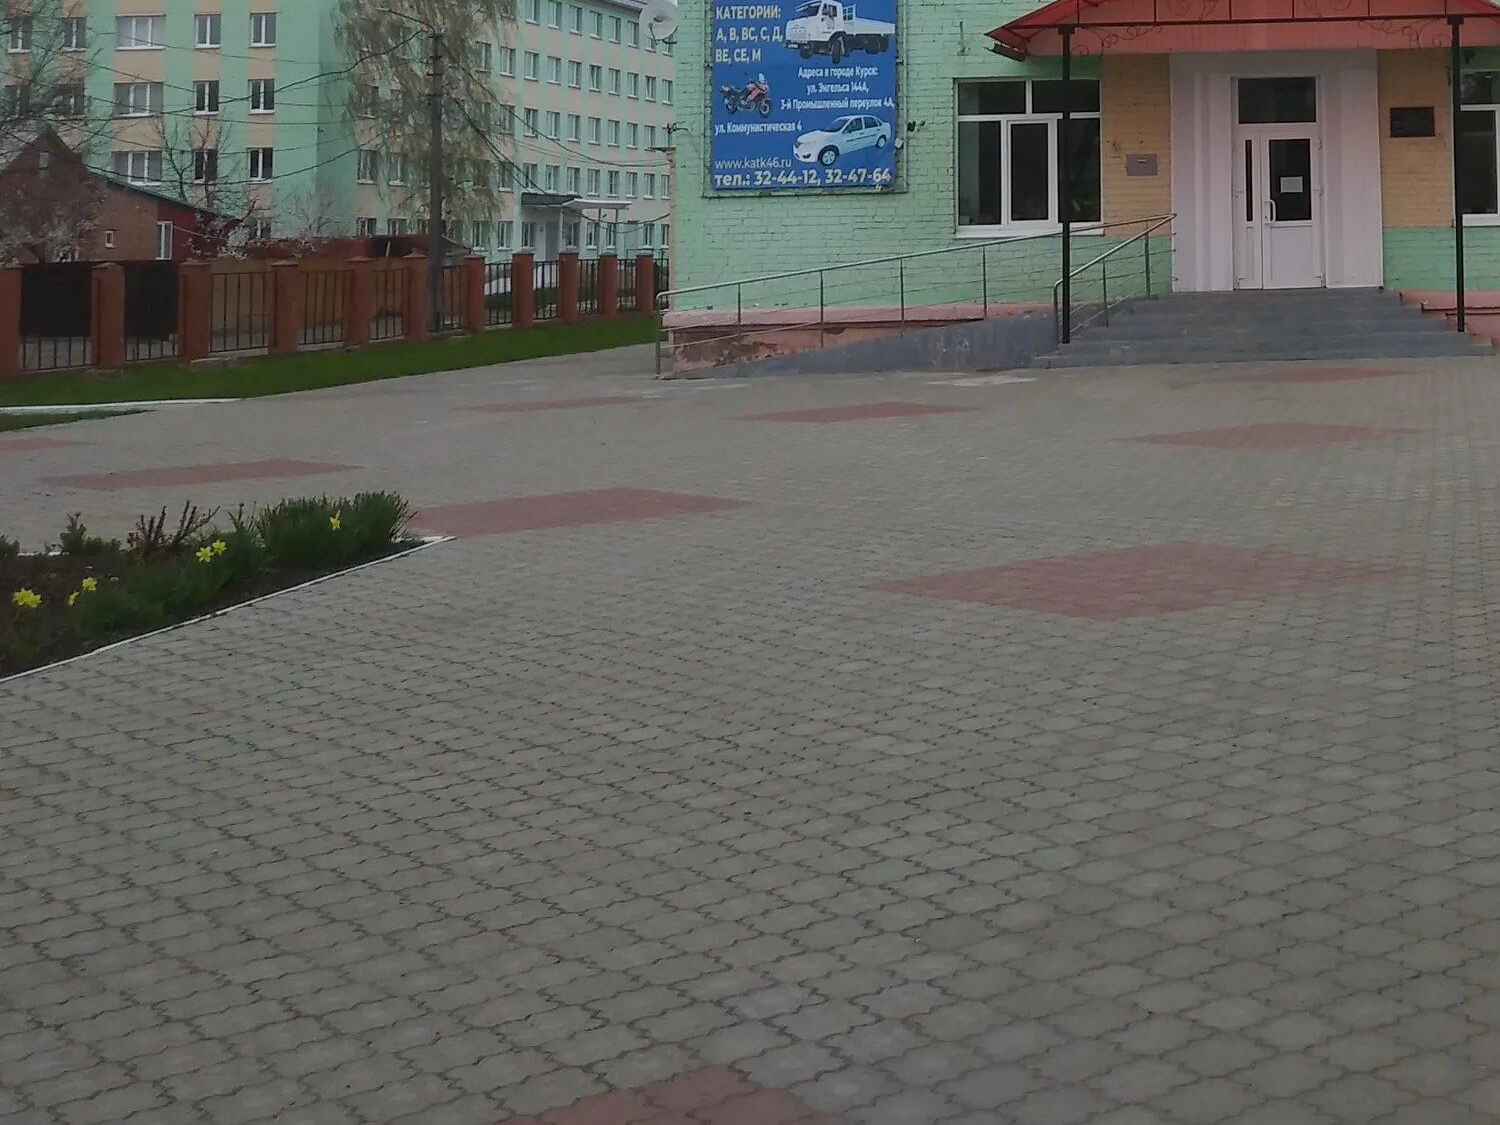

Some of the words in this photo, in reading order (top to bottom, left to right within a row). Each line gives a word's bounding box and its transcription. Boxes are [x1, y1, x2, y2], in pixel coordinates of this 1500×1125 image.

[715, 5, 782, 20] КАТЕГОРИИ:
[751, 47, 762, 62] М
[798, 67, 823, 79] Адреса
[830, 67, 854, 79] городе
[806, 84, 818, 96] ул.
[818, 82, 850, 93] Энгельса
[792, 98, 849, 111] Промышленный
[849, 98, 883, 111] переулок
[714, 124, 726, 136] ул.
[727, 122, 796, 136] Коммунистическая
[714, 156, 792, 170] www.katk46.ru
[715, 174, 751, 187] тел.:
[753, 169, 821, 187] 32-44-12,
[825, 167, 892, 183] 32-47-64
